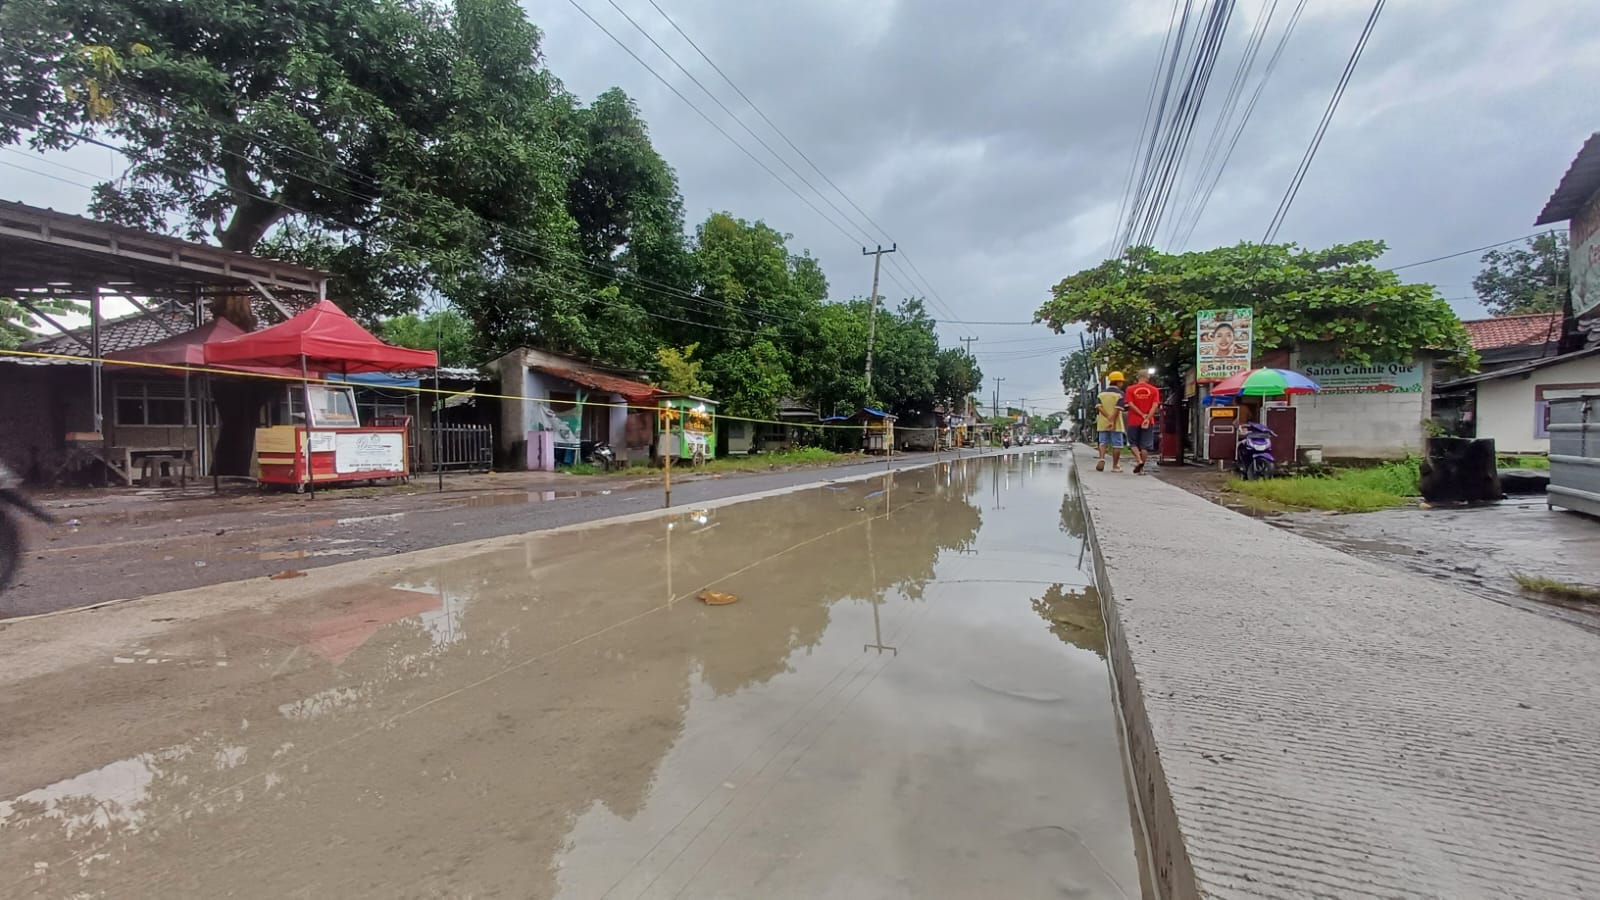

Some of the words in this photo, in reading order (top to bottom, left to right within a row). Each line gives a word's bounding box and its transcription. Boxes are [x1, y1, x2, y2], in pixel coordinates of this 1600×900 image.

[1306, 367, 1340, 376] Salon
[1343, 365, 1385, 375] Cantik
[1388, 363, 1414, 375] Que
